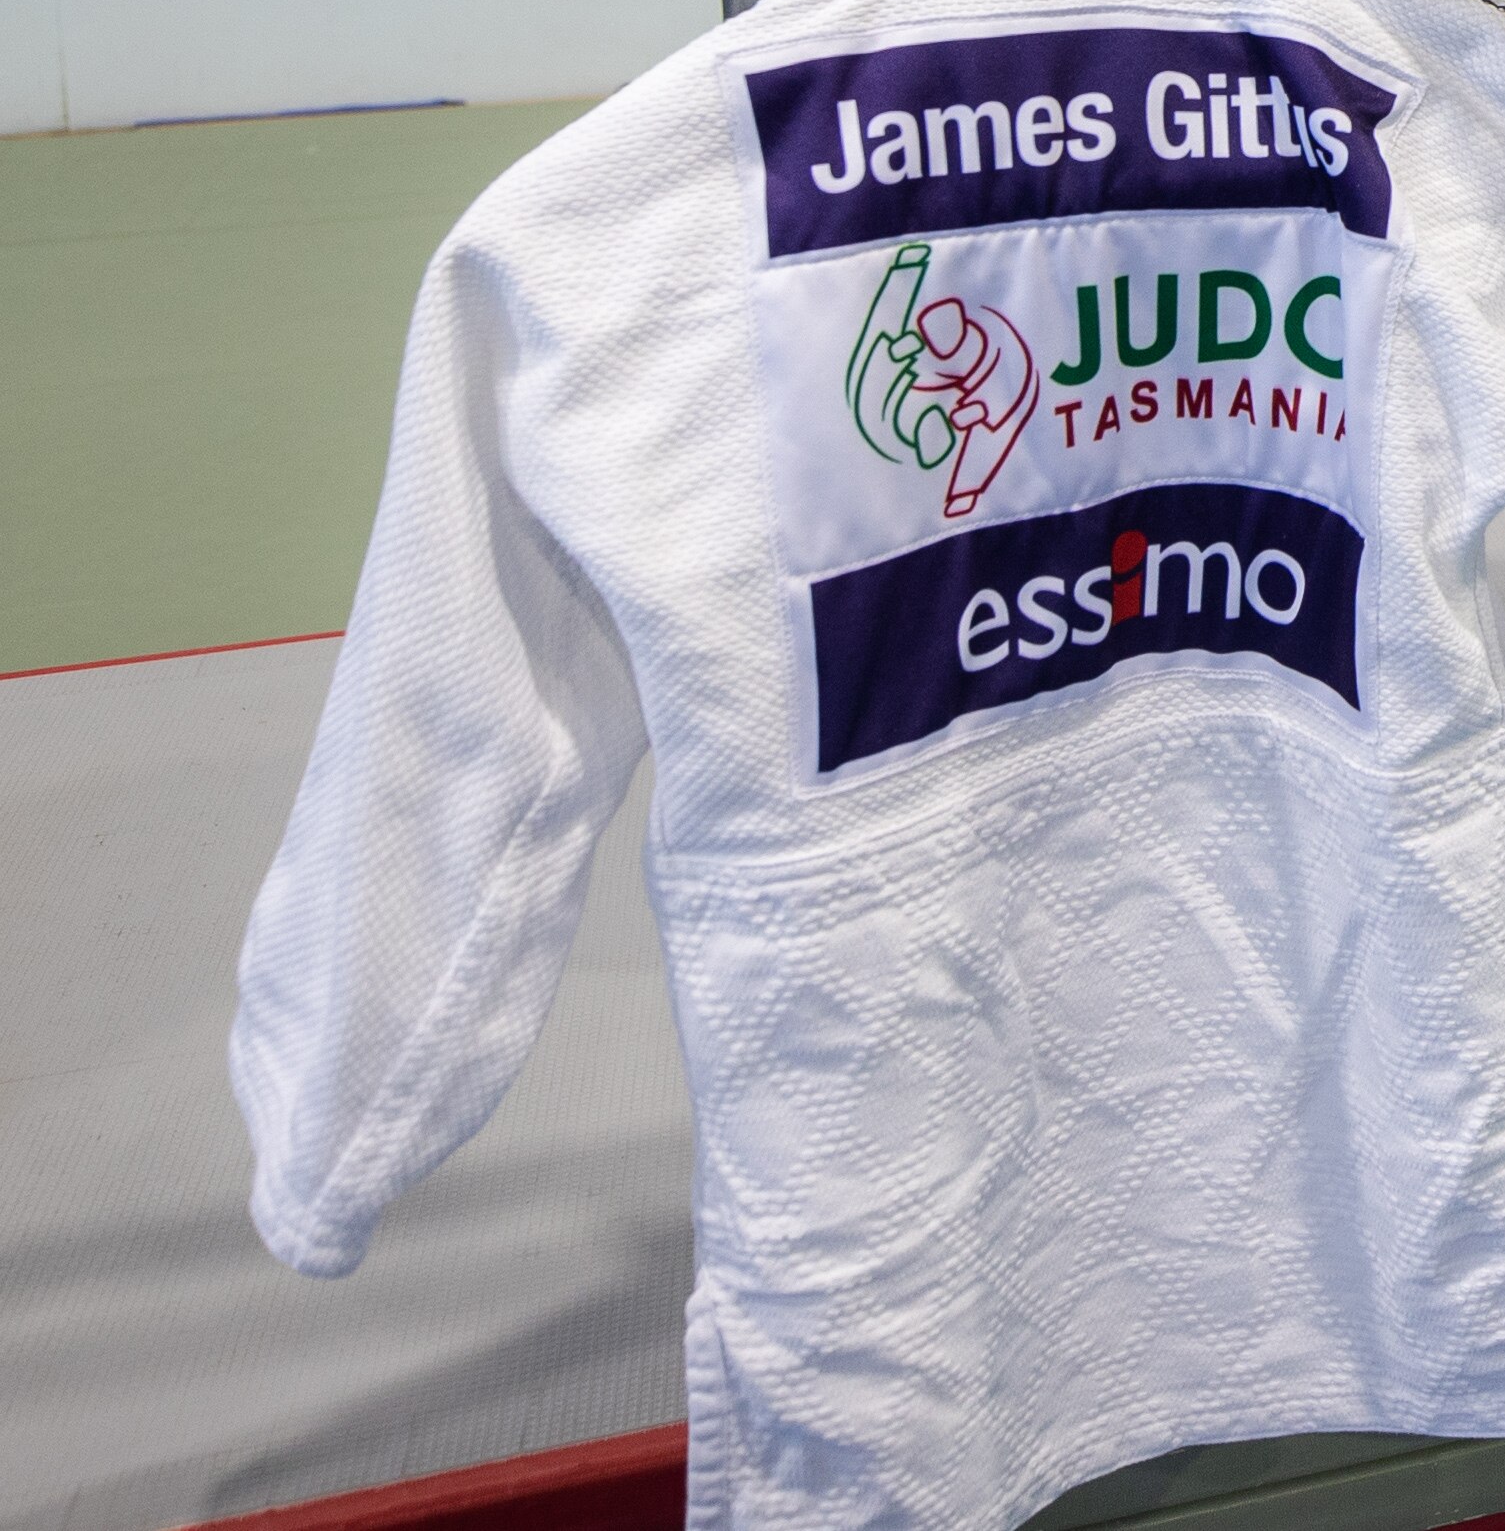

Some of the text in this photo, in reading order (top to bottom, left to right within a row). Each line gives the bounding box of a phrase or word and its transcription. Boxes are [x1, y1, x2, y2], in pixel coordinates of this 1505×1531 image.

[811, 91, 1116, 194] James
[1055, 377, 1346, 447] TASMANI
[957, 531, 1305, 671] essimo
